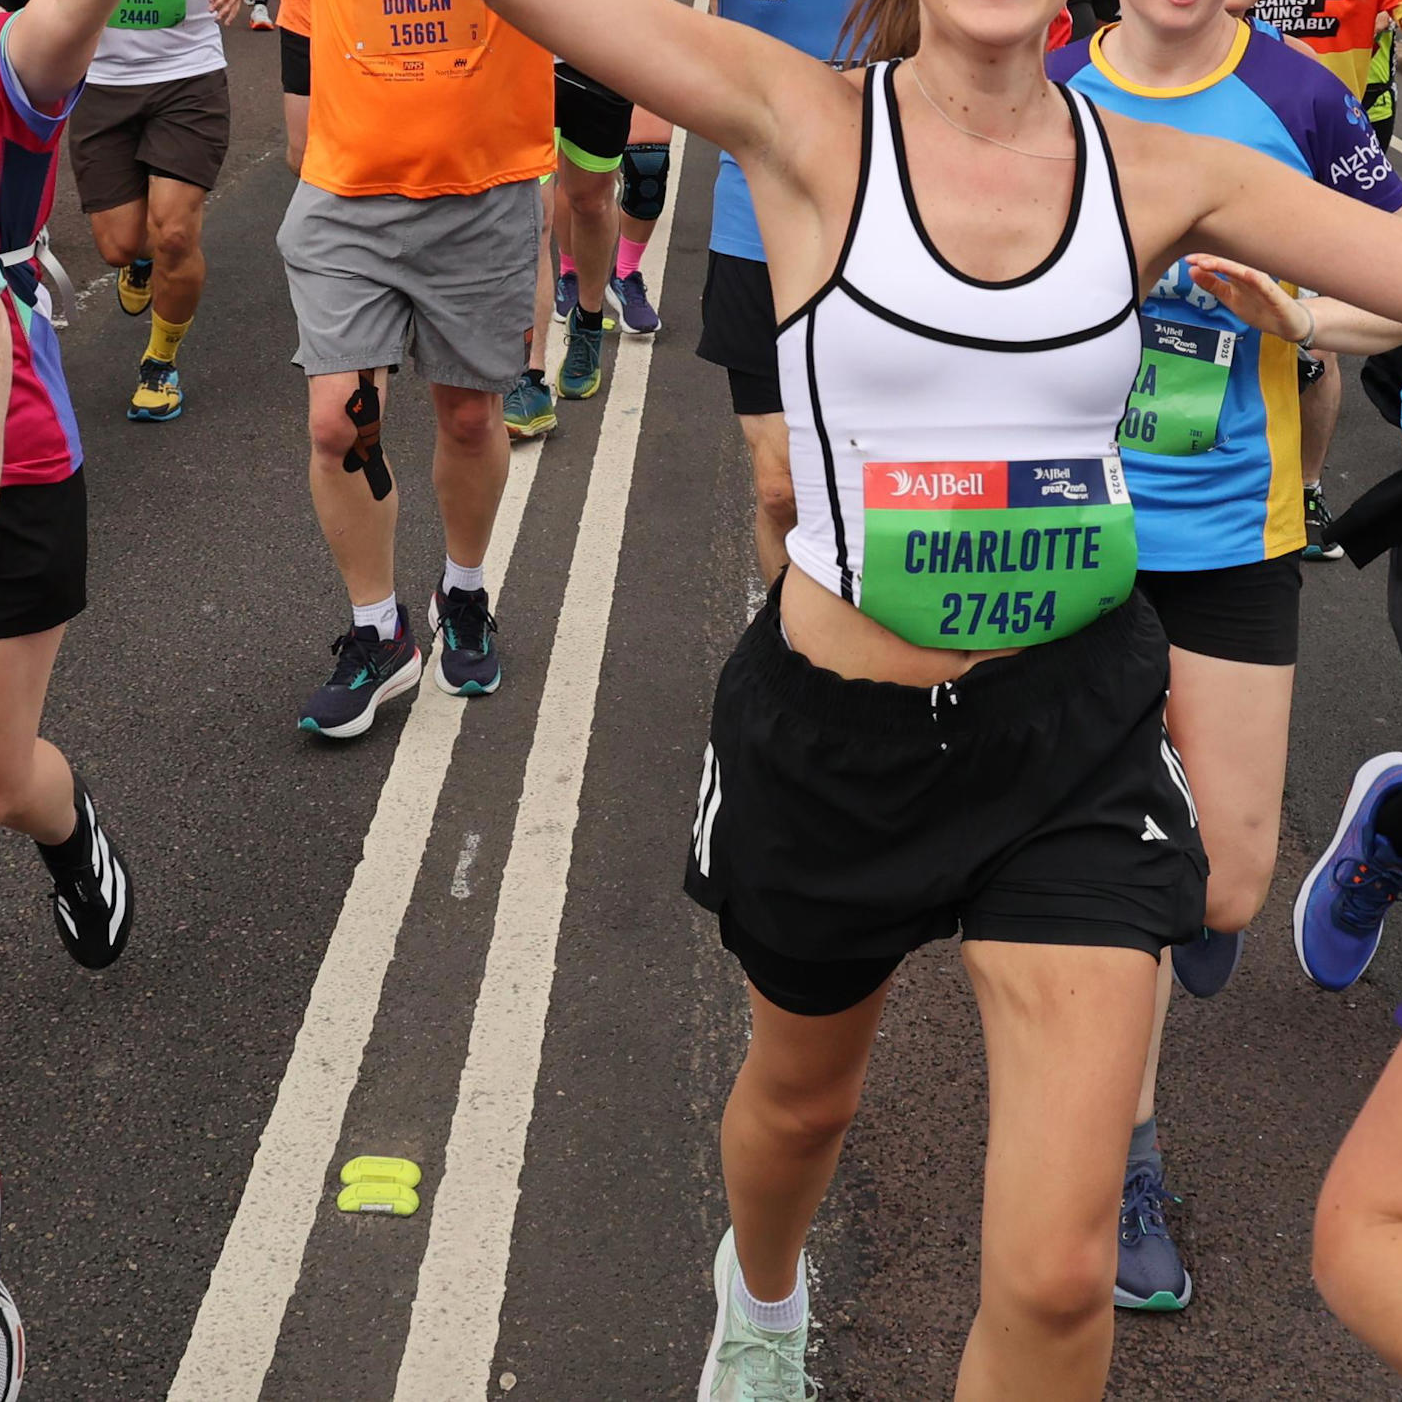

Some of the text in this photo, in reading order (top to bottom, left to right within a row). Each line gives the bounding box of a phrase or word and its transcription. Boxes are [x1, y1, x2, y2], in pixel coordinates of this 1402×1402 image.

[390, 21, 448, 47] 15661
[1221, 337, 1232, 359] 2025
[912, 472, 984, 500] AJBell
[1109, 468, 1123, 495] 2025
[904, 526, 1102, 574] CHARLOTTE
[939, 591, 1056, 635] 27454
